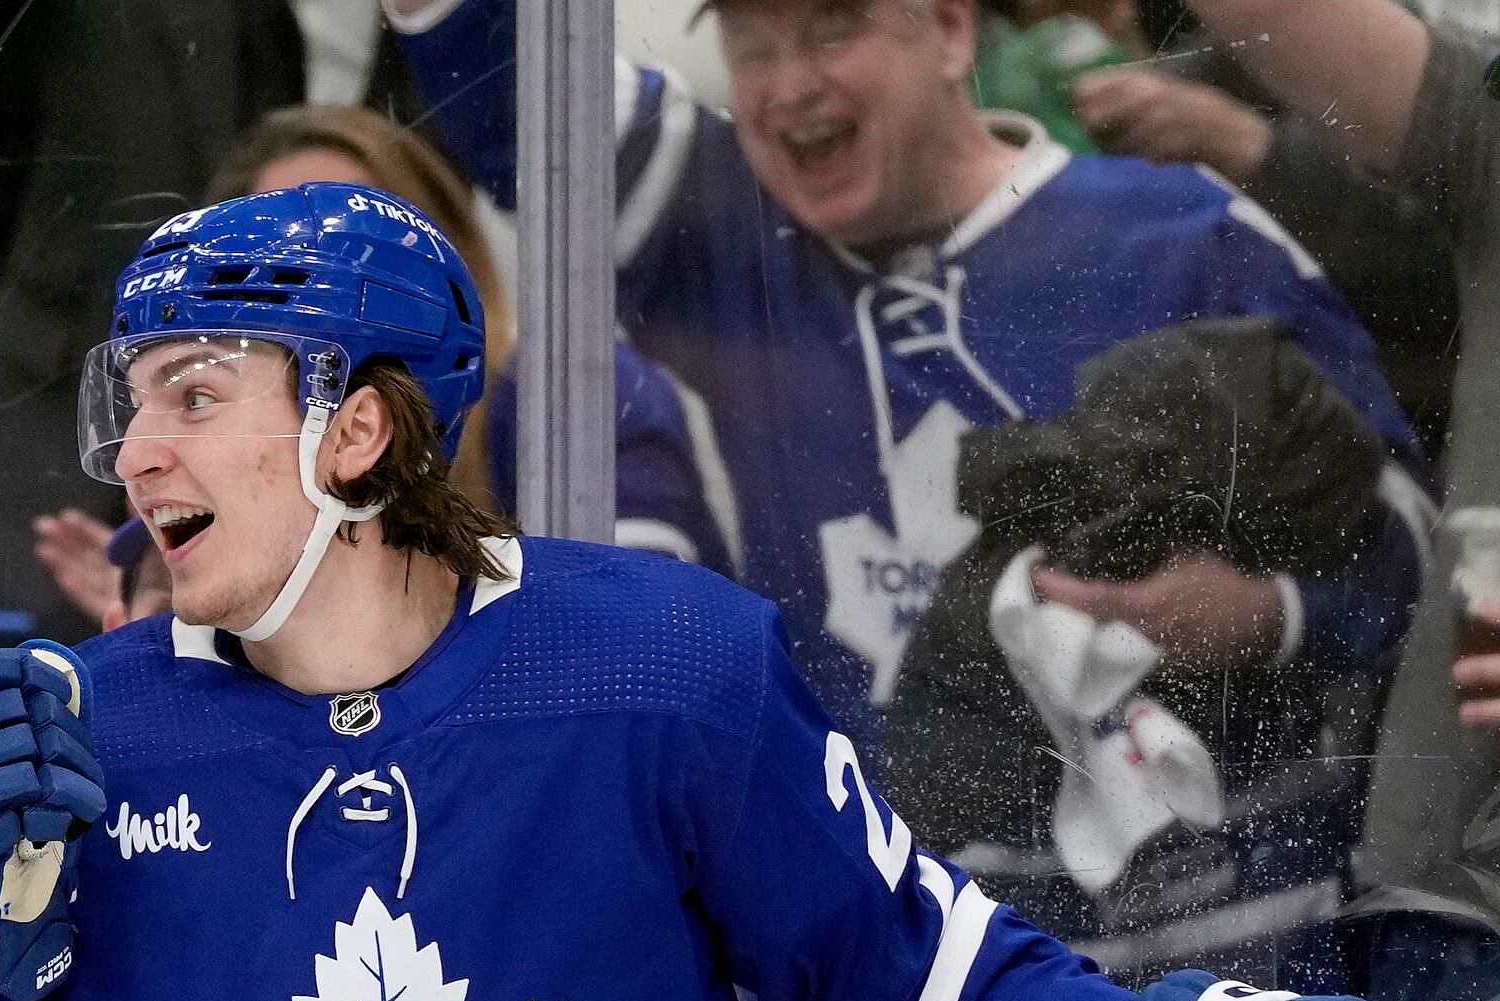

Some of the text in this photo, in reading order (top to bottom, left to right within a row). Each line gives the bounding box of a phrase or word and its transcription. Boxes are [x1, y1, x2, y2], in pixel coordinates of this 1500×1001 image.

[369, 200, 442, 242] TikTok
[123, 267, 188, 299] CCM
[305, 396, 341, 411] CCM
[341, 701, 369, 727] NHL
[105, 793, 212, 860] Milk
[36, 951, 72, 990] CCM
